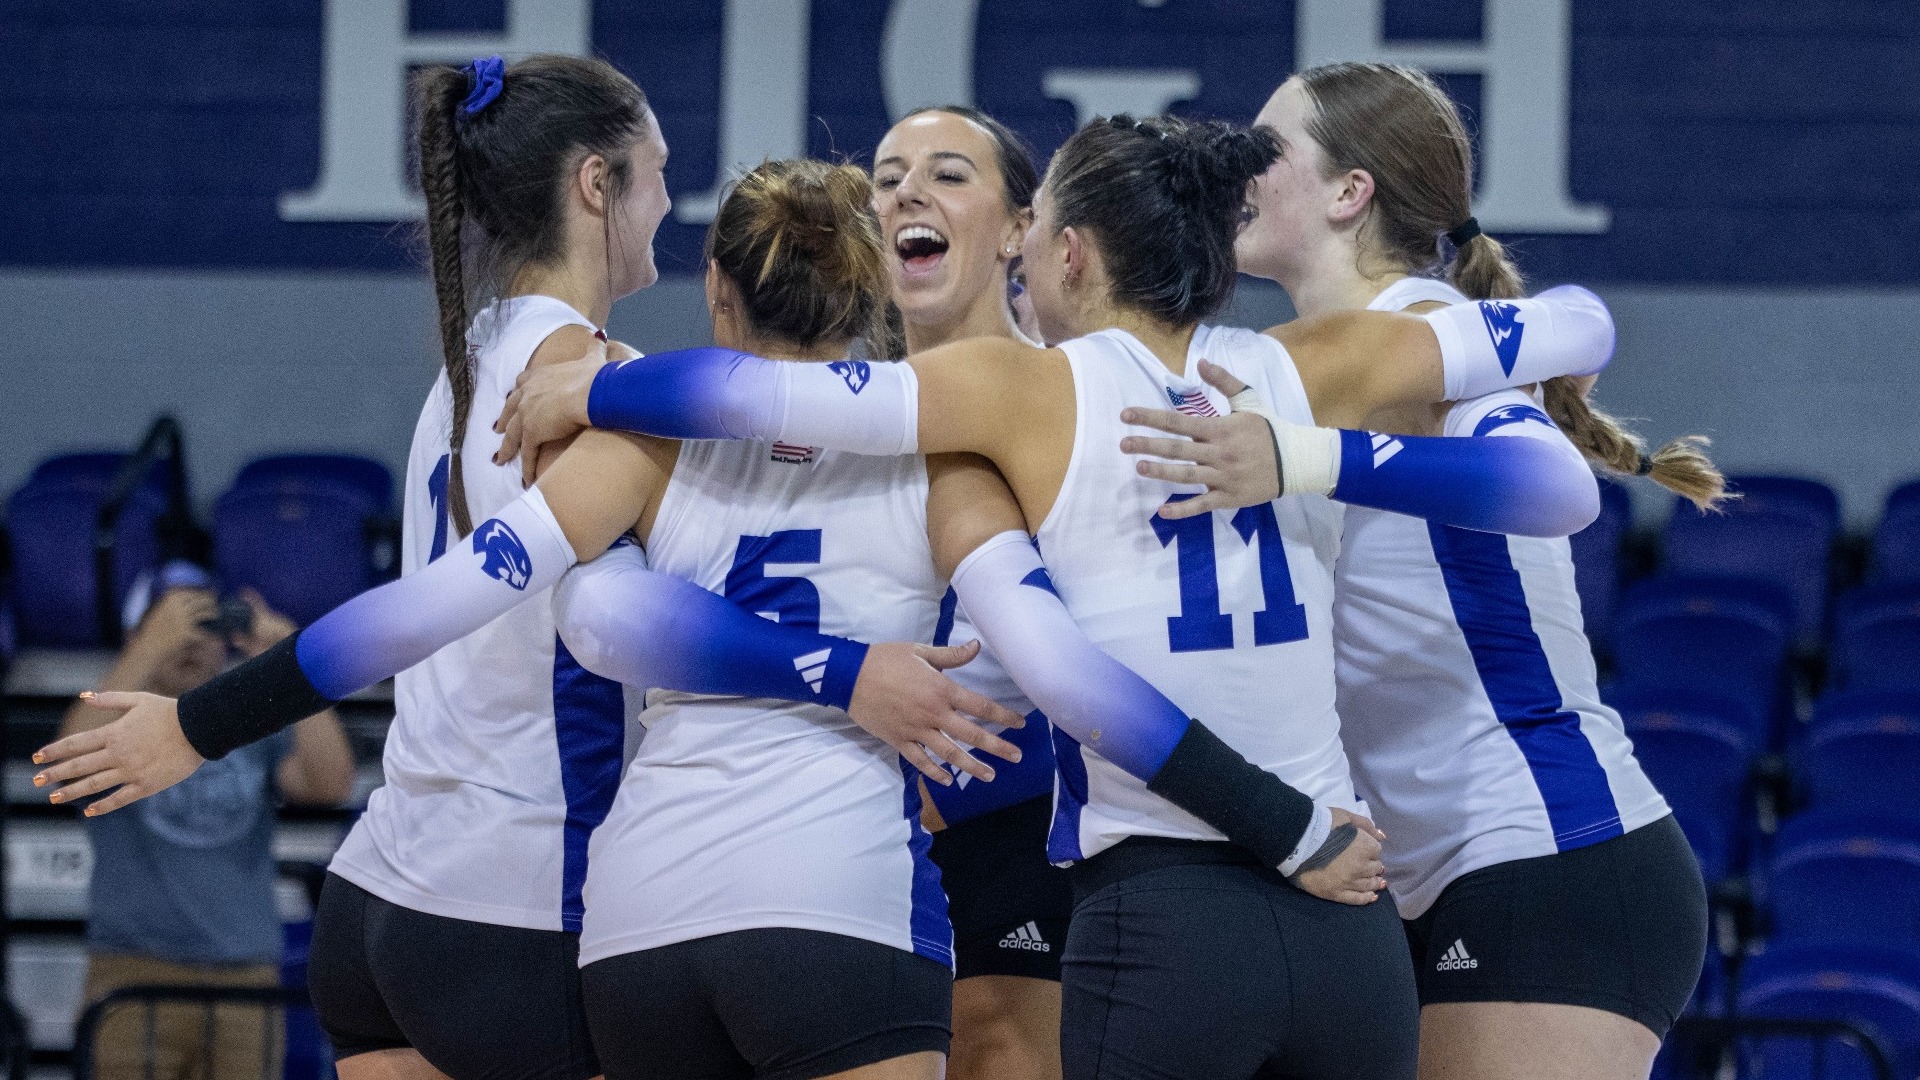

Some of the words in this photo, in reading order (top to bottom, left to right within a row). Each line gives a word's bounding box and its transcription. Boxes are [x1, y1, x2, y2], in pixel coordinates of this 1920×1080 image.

[724, 528, 822, 636] 5
[1149, 493, 1309, 653] 11
[998, 937, 1050, 952] adidas
[1436, 958, 1478, 971] adidas
